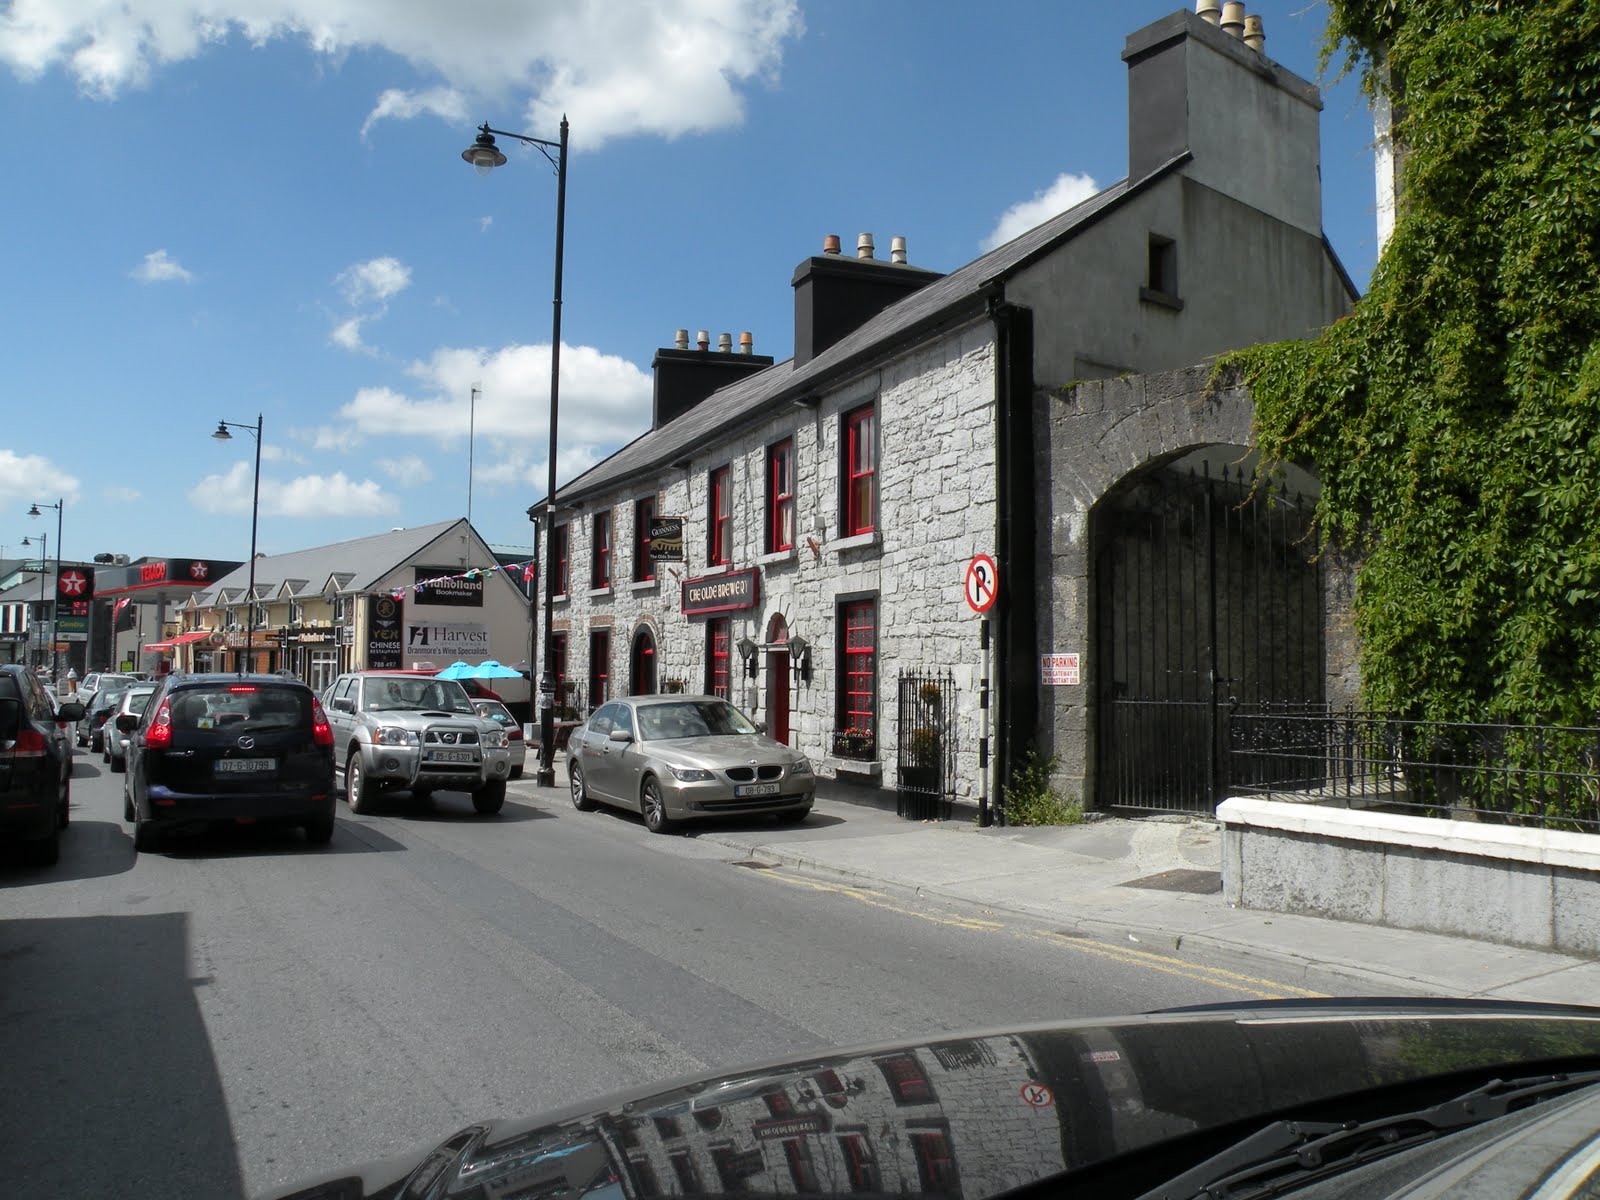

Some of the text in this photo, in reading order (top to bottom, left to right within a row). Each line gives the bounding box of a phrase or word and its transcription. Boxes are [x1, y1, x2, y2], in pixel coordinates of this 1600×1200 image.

[651, 524, 680, 537] GUINNESS
[436, 589, 473, 597] Bookmaker
[689, 580, 748, 602] THE OLDE BREWERY
[434, 626, 488, 642] Harvest
[370, 641, 401, 649] CHINESE
[407, 646, 488, 656] Oranmore's Wine Specialists
[1042, 657, 1078, 668] NO PARKING
[222, 760, 270, 771] 07-G-10799
